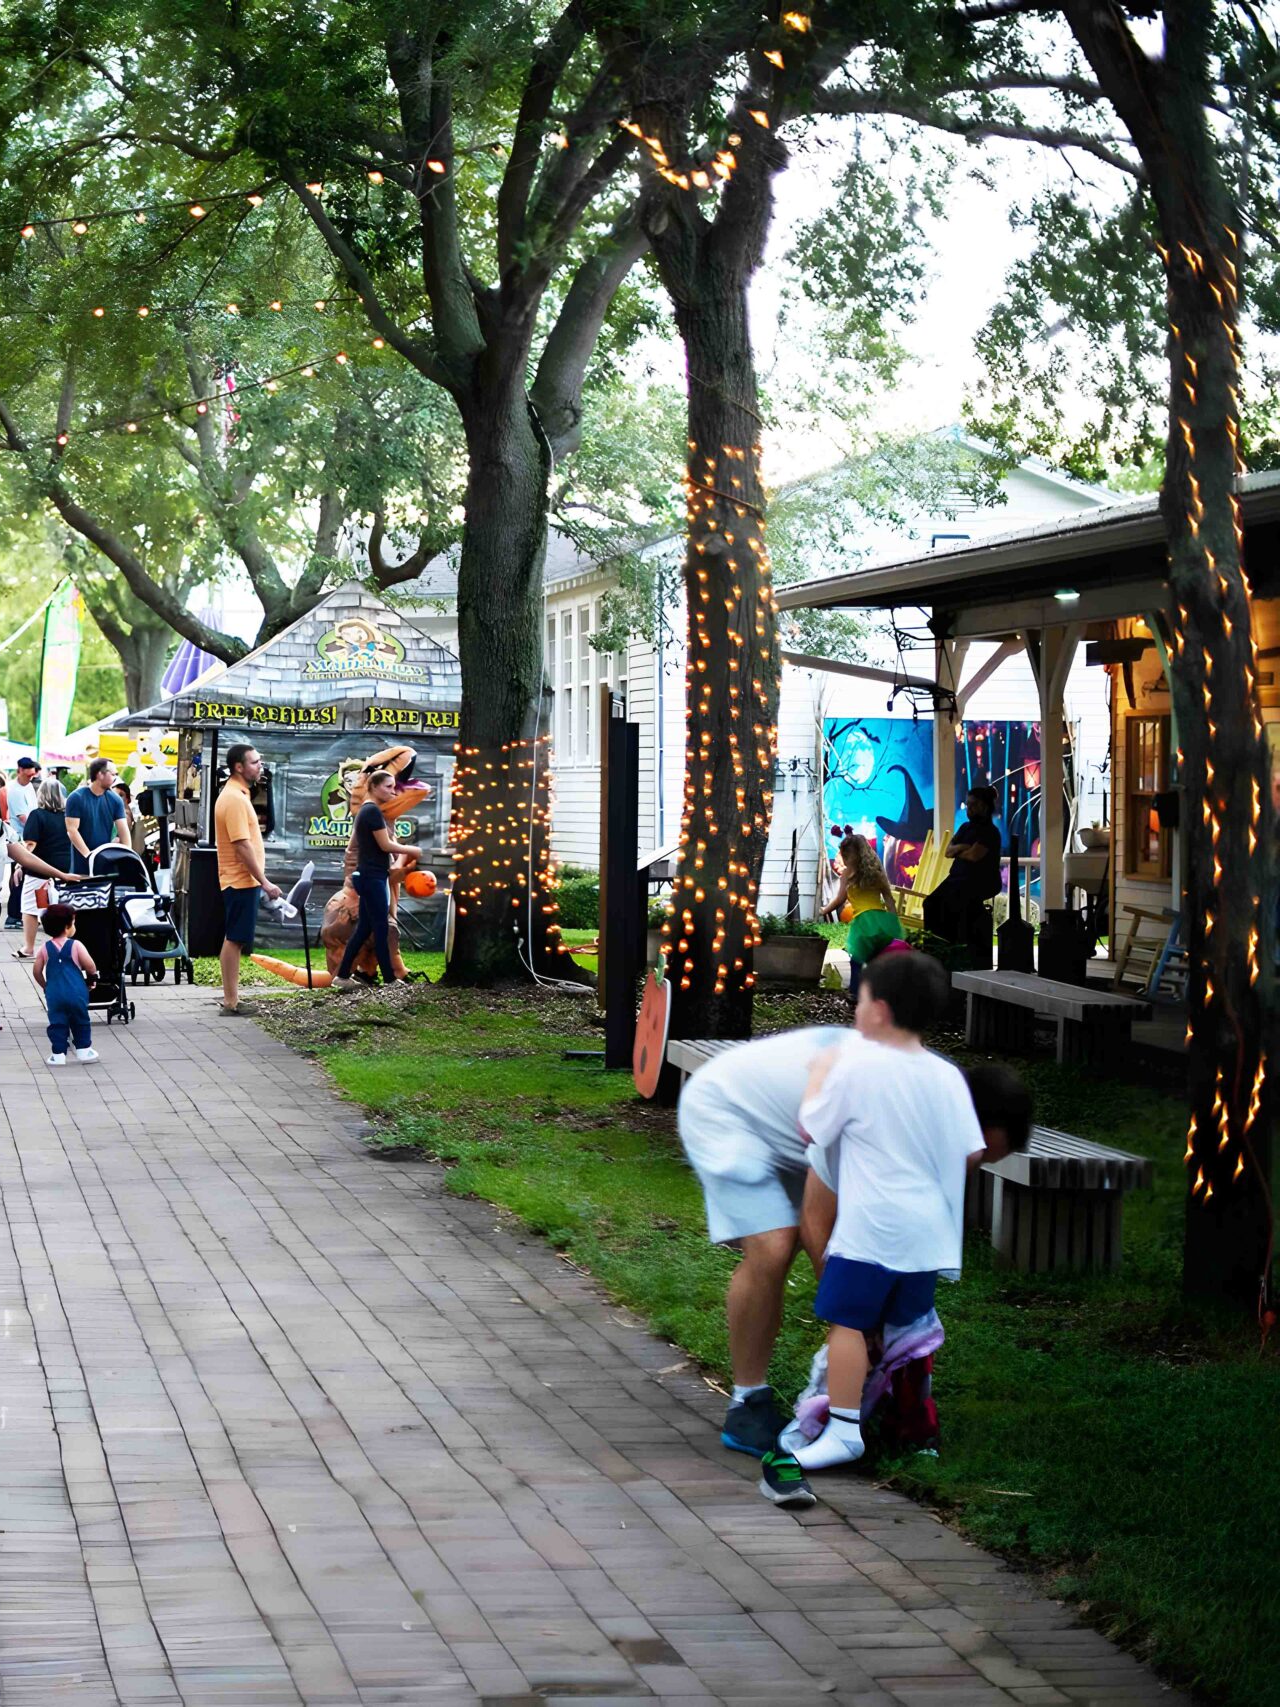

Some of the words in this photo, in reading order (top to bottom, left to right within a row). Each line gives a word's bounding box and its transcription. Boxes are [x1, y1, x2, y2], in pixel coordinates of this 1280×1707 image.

[193, 701, 246, 721] FREE
[252, 706, 337, 724] REFILLS!
[369, 706, 419, 725] FREE
